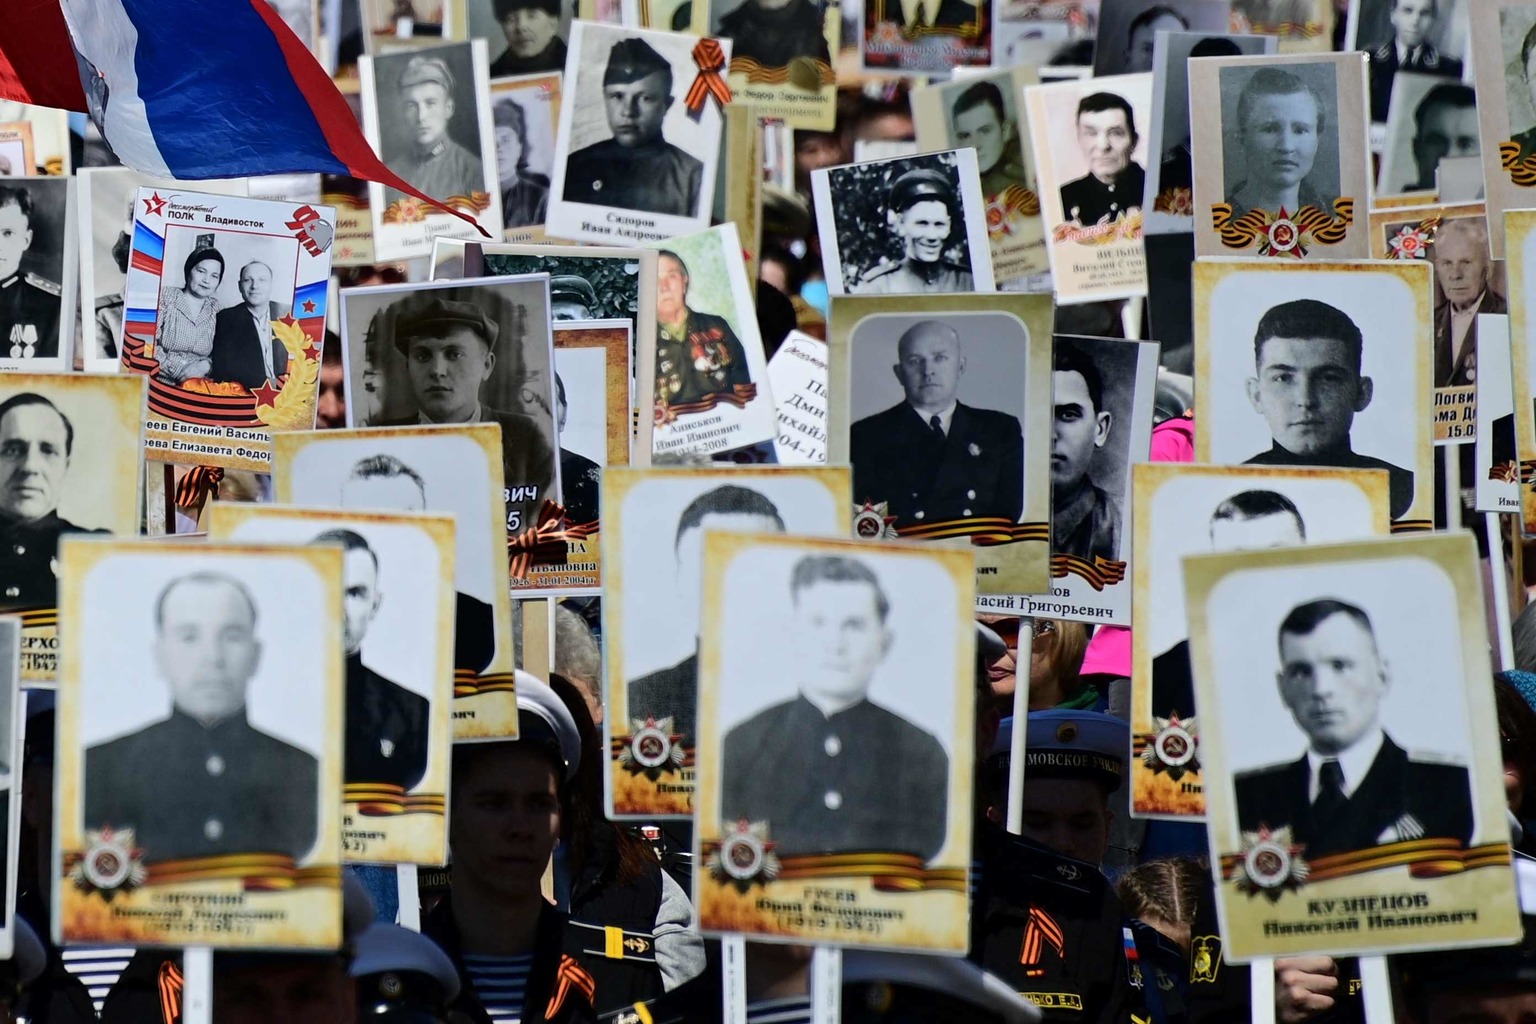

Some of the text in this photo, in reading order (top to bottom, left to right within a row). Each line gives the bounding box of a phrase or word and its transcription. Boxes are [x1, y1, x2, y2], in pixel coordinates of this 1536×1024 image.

[168, 210, 265, 229] ПОЛК Владивосток
[581, 221, 611, 235] Иван
[172, 422, 221, 437] Евгений
[686, 423, 741, 444] Иванович
[172, 440, 233, 455] Елизавета
[1019, 596, 1114, 618] Григорьевич
[1307, 893, 1429, 916] КУЗНЕЦОВ
[1263, 911, 1478, 937] Николай Иванович
